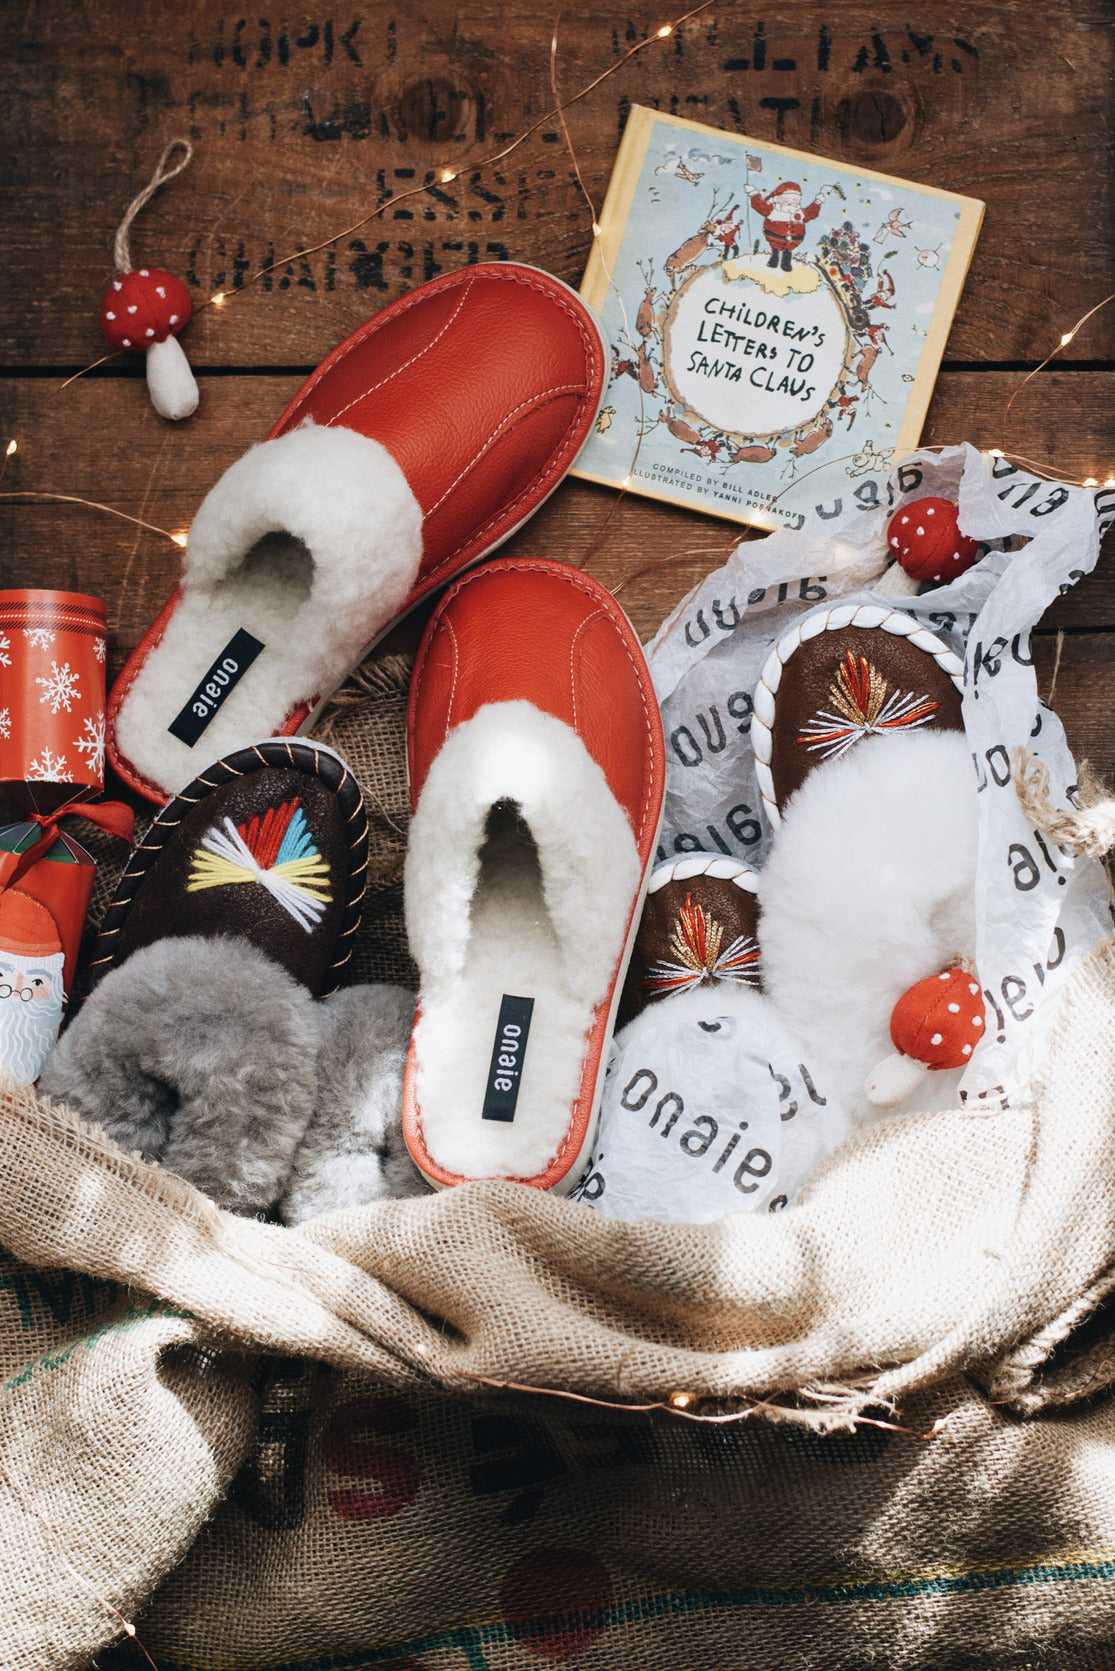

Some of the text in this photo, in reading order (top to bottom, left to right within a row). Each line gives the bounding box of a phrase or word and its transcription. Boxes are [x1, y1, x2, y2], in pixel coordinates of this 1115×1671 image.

[697, 320, 815, 373] LETTERS TO
[686, 350, 816, 402] SANTA CLAUS
[630, 467, 693, 490] LLUSTRATED
[697, 486, 710, 495] BY
[713, 491, 742, 504] YANNI
[652, 463, 702, 482] COMPILED
[706, 478, 720, 487] BY
[722, 482, 743, 494] BILL
[192, 658, 239, 718] onaie
[493, 1023, 522, 1092] onaie
[620, 1068, 773, 1194] onaie
